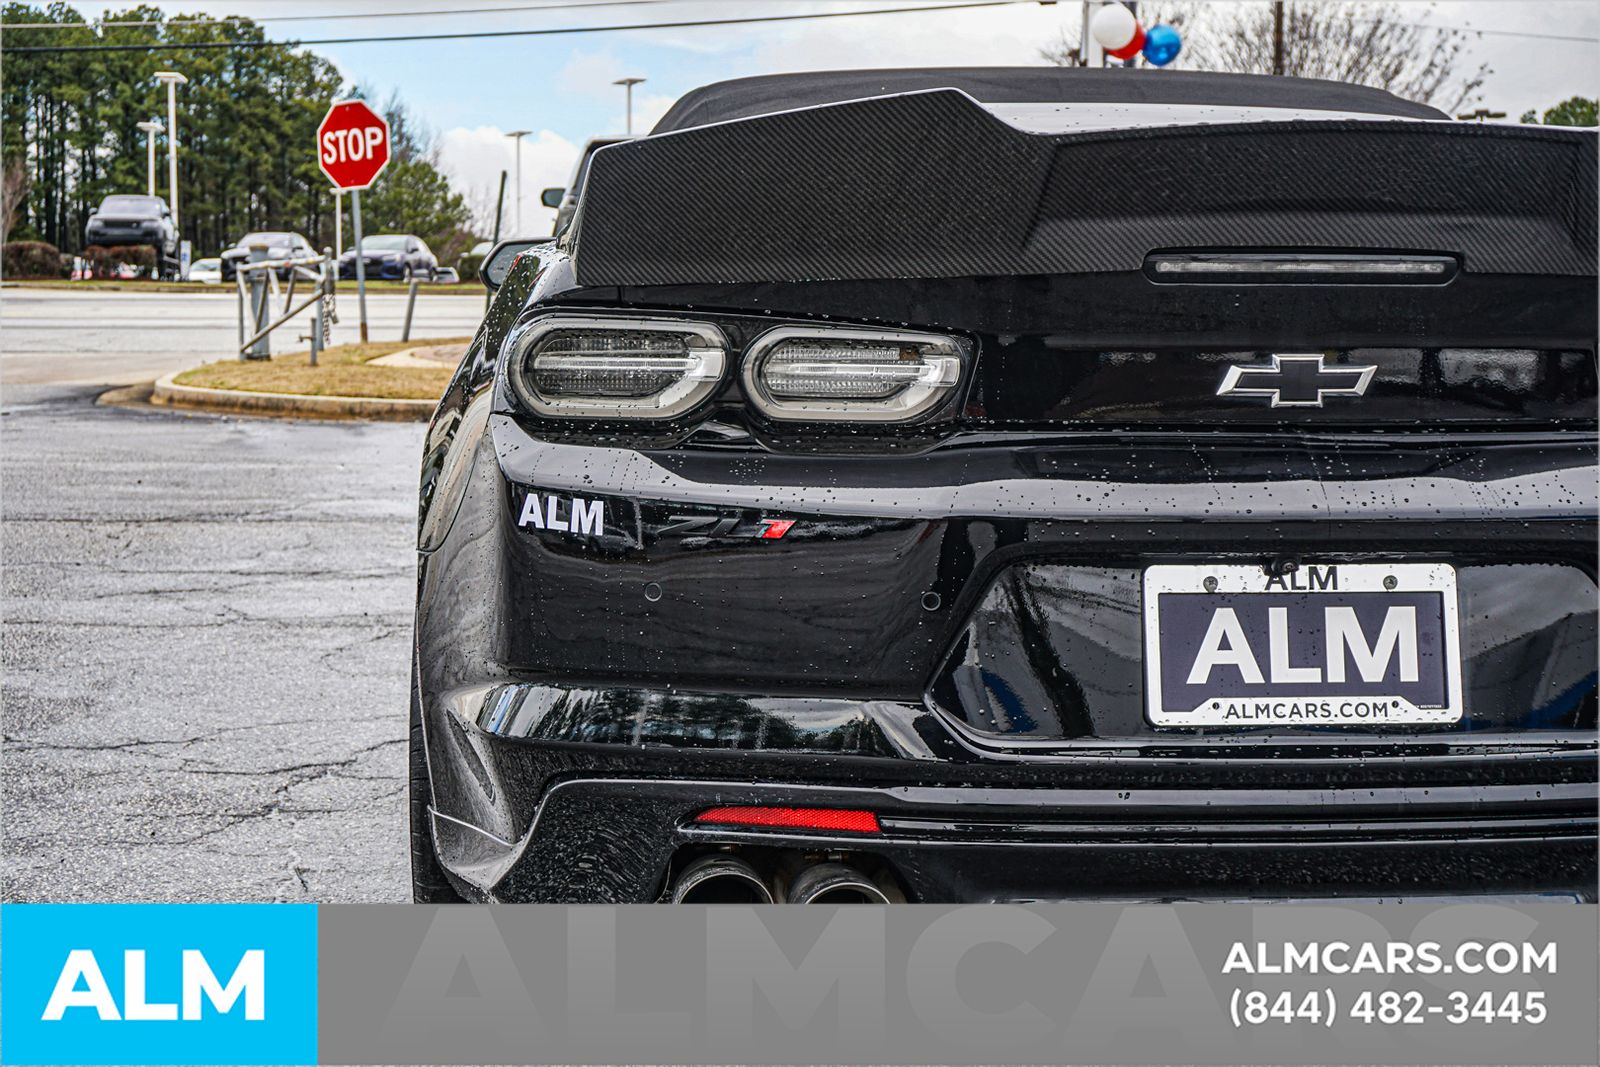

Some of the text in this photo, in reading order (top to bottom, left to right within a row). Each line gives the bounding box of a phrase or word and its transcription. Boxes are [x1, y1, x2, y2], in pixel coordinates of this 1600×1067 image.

[323, 126, 384, 165] STOP
[518, 493, 604, 536] ALM
[657, 515, 797, 539] ZL1
[1264, 566, 1338, 591] ALM
[1186, 606, 1419, 684] ALM
[1225, 702, 1389, 719] ALMCARS.COM
